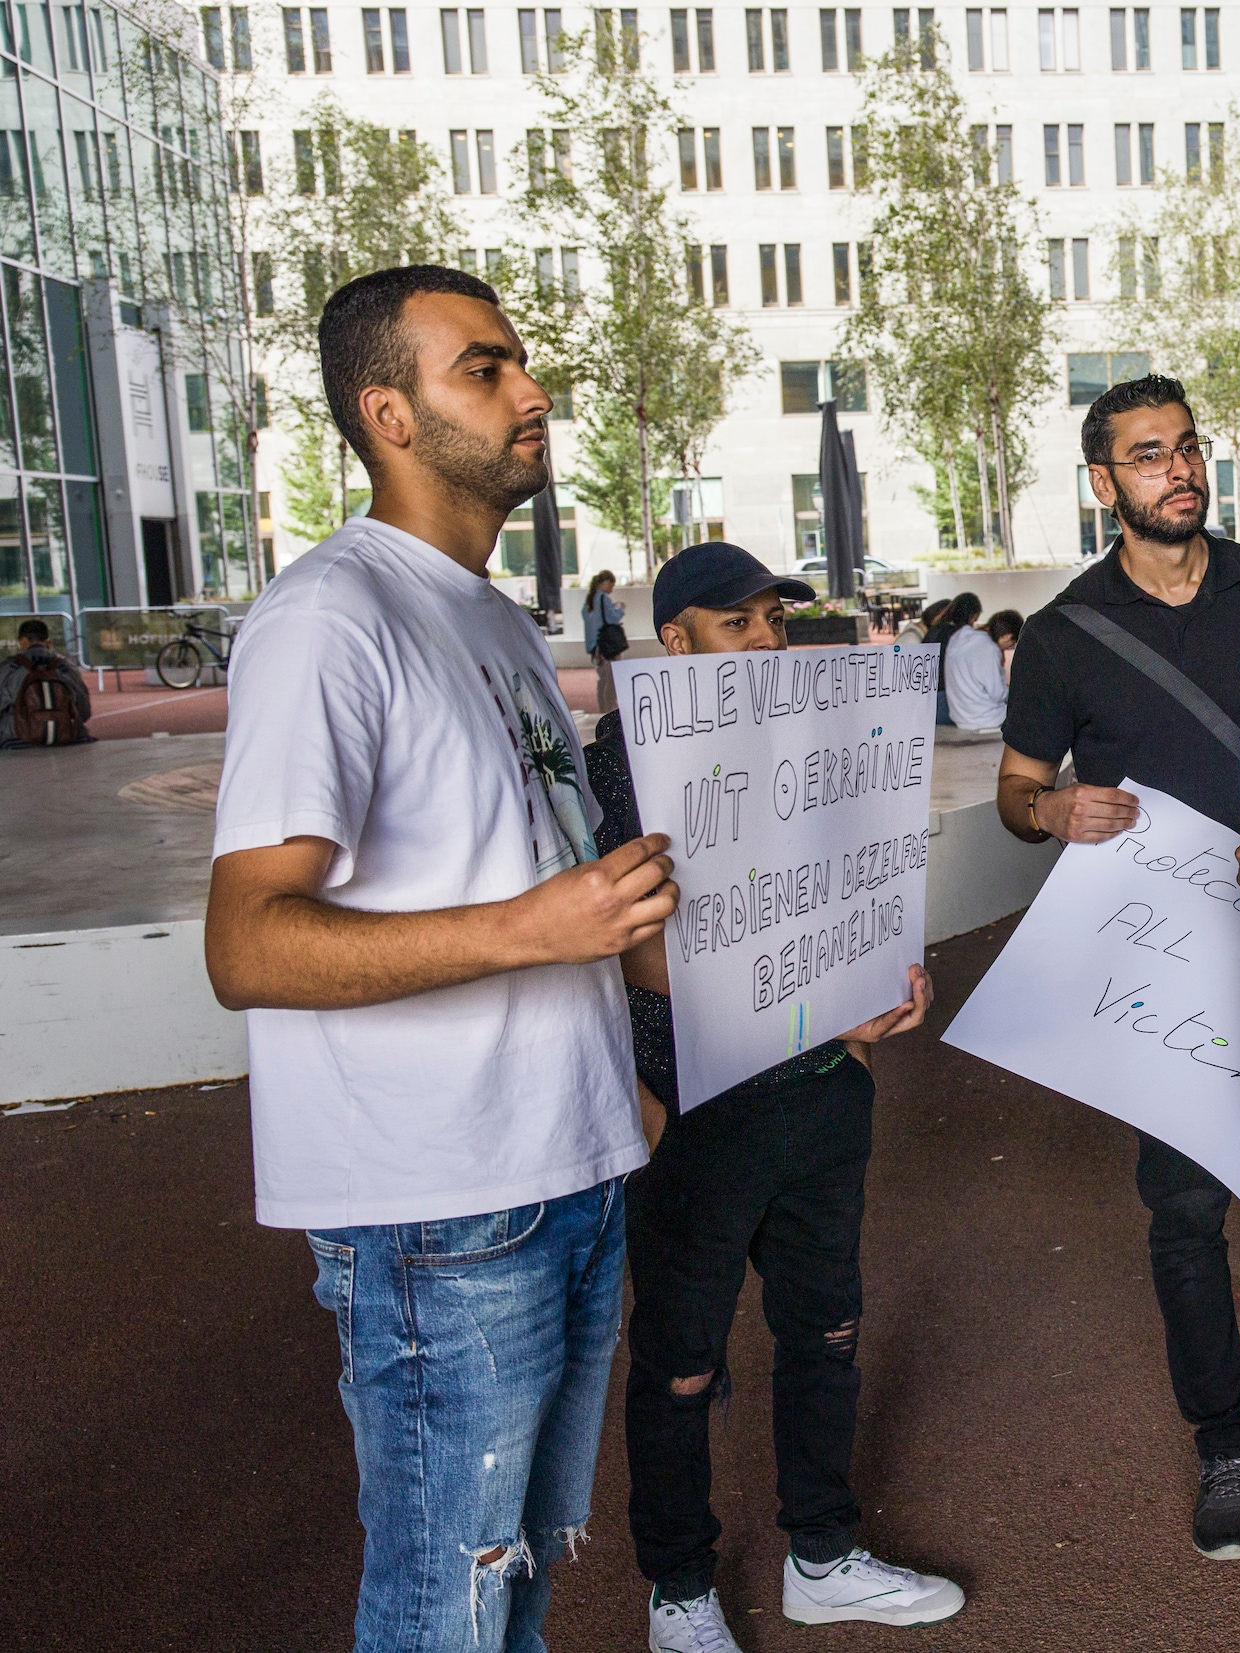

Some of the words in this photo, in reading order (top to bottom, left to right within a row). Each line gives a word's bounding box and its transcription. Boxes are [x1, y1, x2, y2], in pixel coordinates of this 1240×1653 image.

[632, 661, 738, 746] ALLE
[841, 829, 929, 900] DEZELFDE
[1097, 902, 1192, 962] ALL
